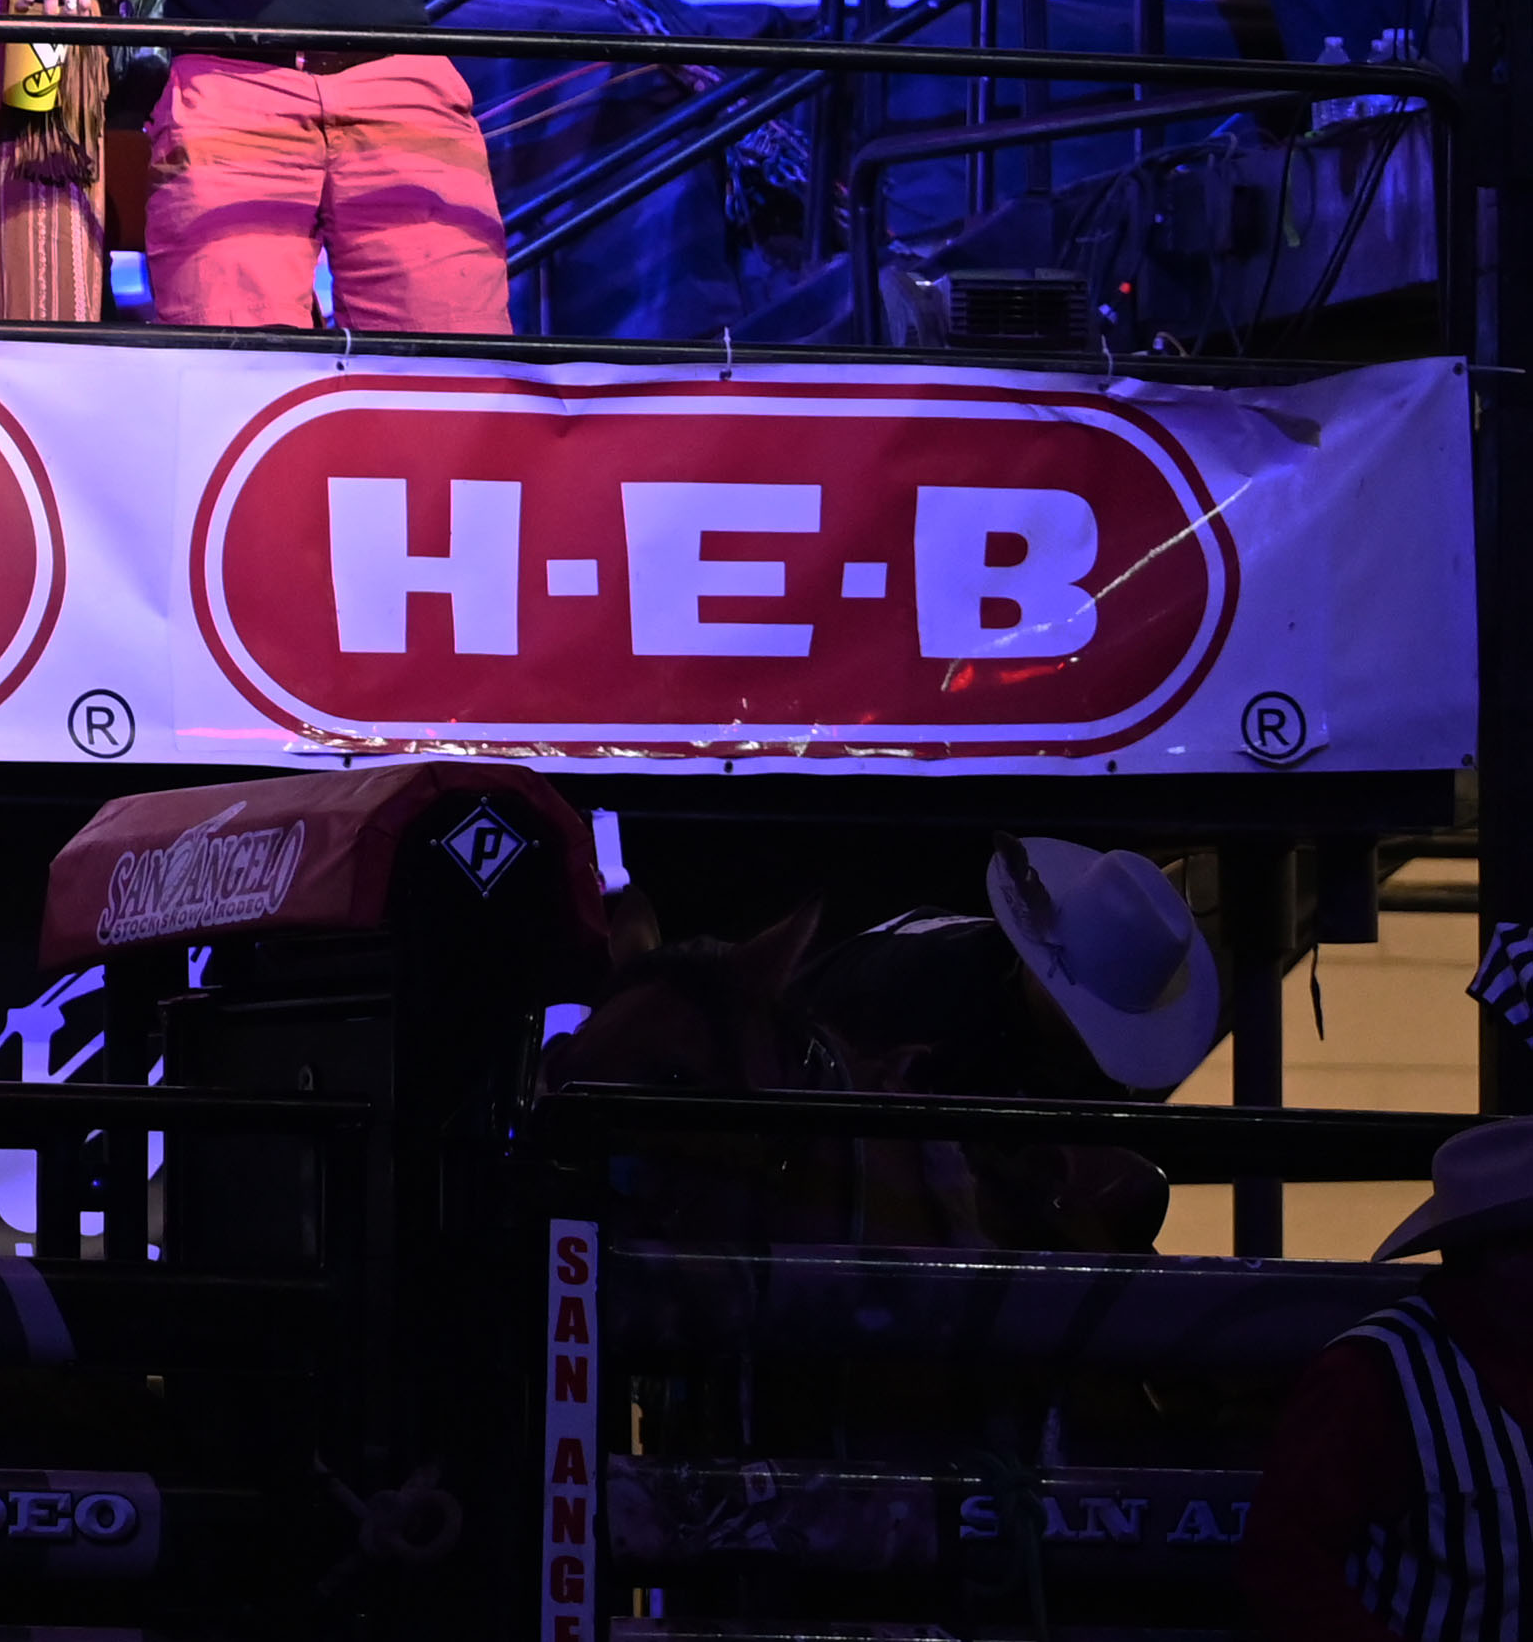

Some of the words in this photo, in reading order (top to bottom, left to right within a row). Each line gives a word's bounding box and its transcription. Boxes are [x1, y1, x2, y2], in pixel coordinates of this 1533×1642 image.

[97, 850, 177, 944] SAN
[167, 819, 306, 916] ANGELO
[555, 1237, 589, 1403] SAN
